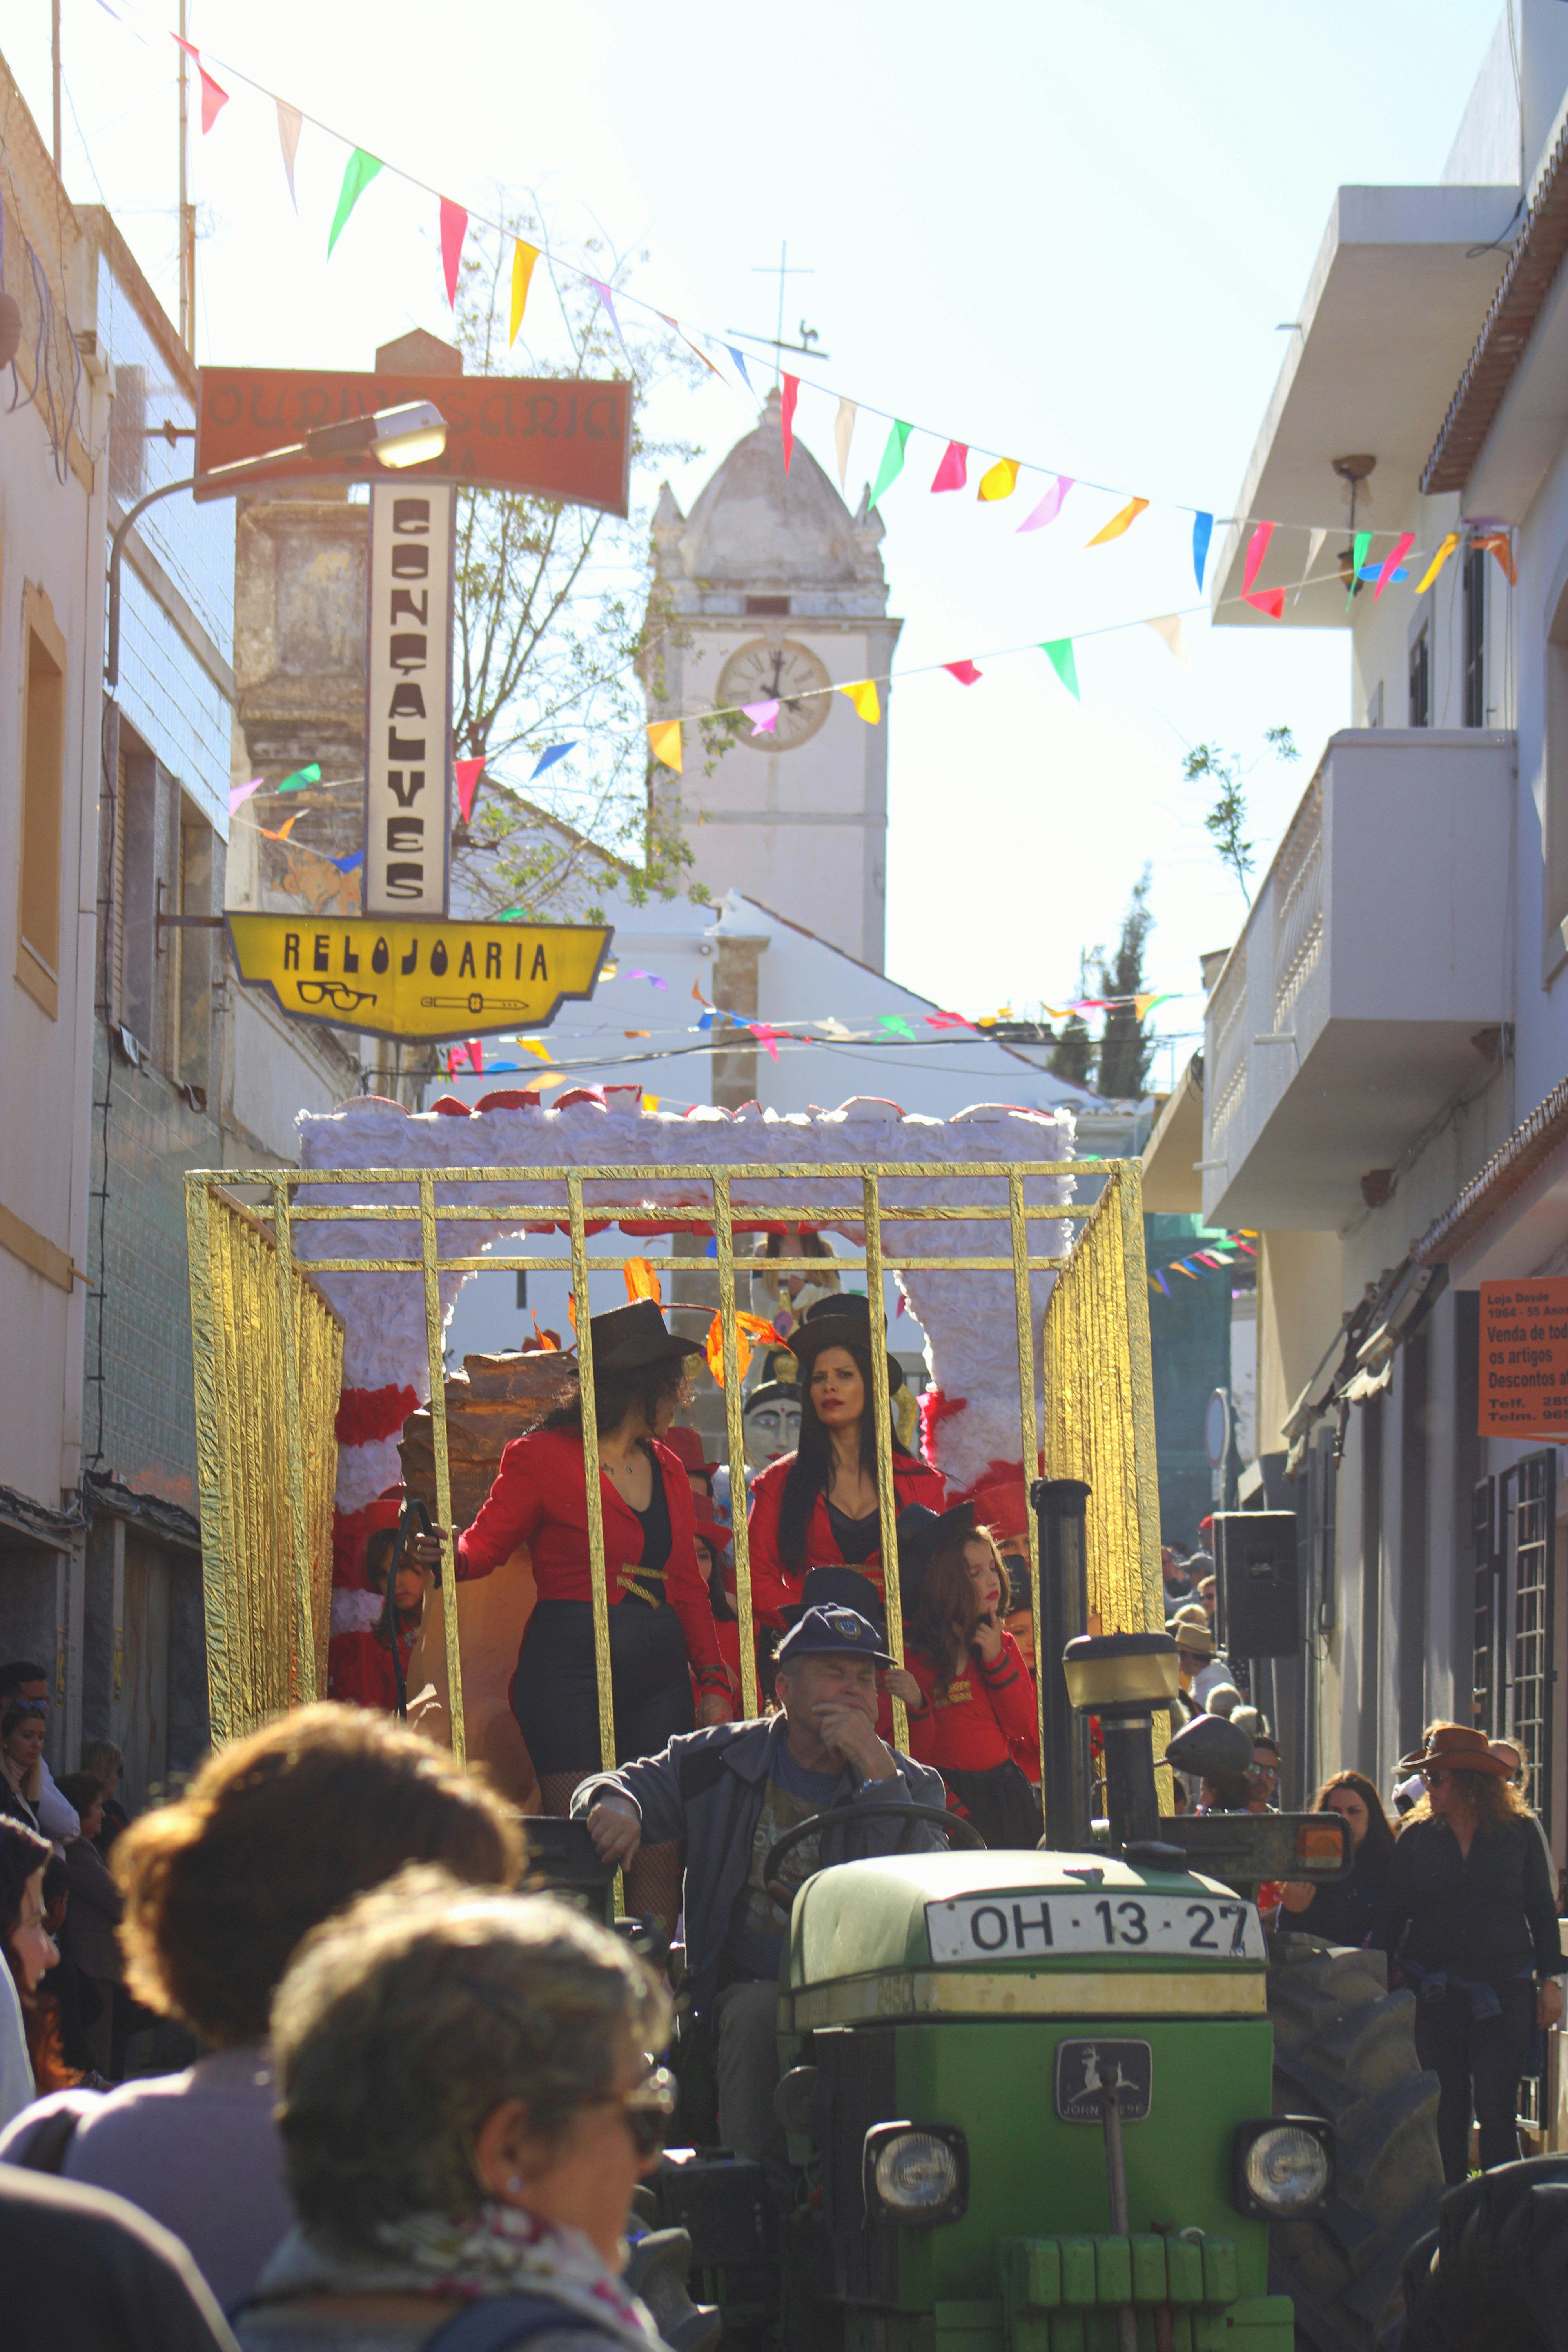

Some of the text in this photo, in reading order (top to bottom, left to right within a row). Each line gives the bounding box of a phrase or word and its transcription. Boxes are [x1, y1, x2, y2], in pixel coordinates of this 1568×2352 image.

[283, 933, 548, 981] RELOJOARIA
[1488, 1292, 1549, 1306] Loja Desde
[1489, 1307, 1516, 1318] 1964
[1527, 1306, 1539, 1317] 55
[1488, 1325, 1527, 1342] Venda
[1531, 1323, 1545, 1340] de
[1490, 1346, 1552, 1367] os artigos
[1489, 1371, 1555, 1388] Descontos
[1488, 1398, 1525, 1408] Telf.
[1063, 2105, 1098, 2116] JOHN
